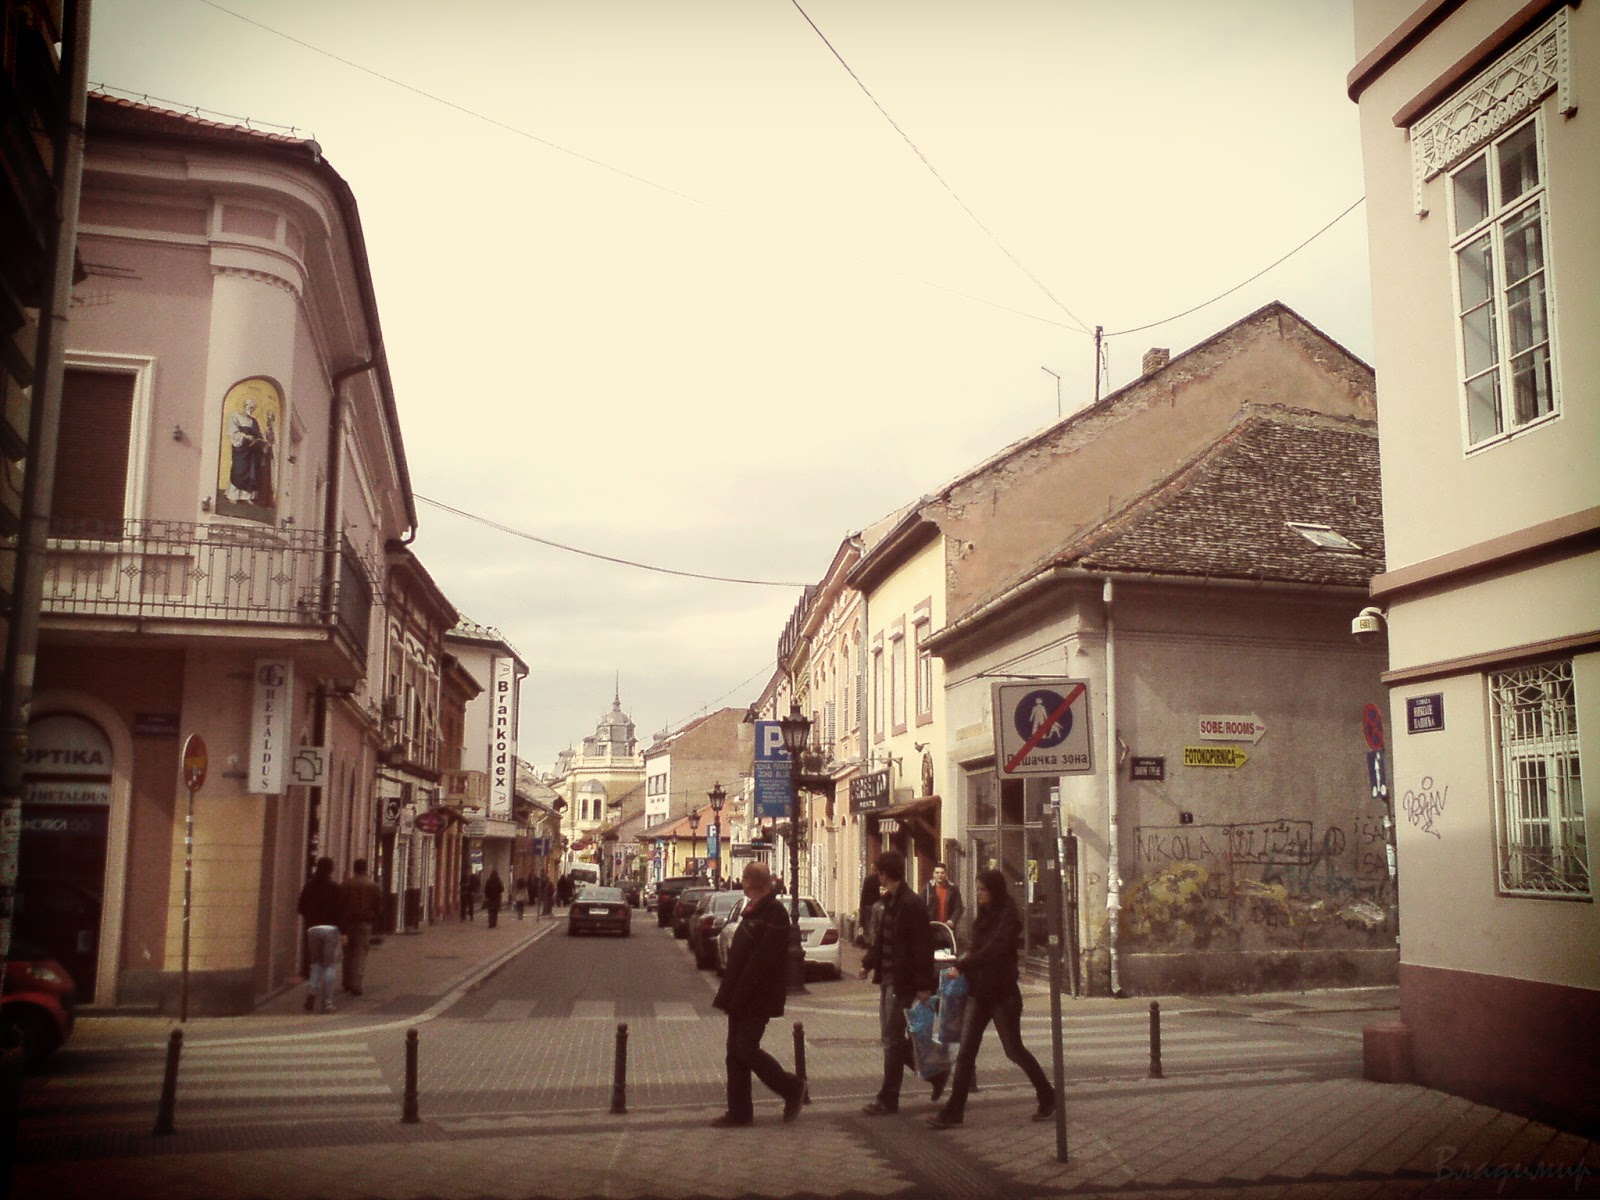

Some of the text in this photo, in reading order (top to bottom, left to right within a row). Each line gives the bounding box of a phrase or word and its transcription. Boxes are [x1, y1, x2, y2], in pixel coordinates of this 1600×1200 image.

[495, 680, 509, 787] Brankodex
[763, 725, 785, 756] P
[1062, 753, 1088, 765] зона
[1184, 748, 1236, 765] FOTOKOPIRNICA
[1137, 834, 1217, 863] NIKOLA
